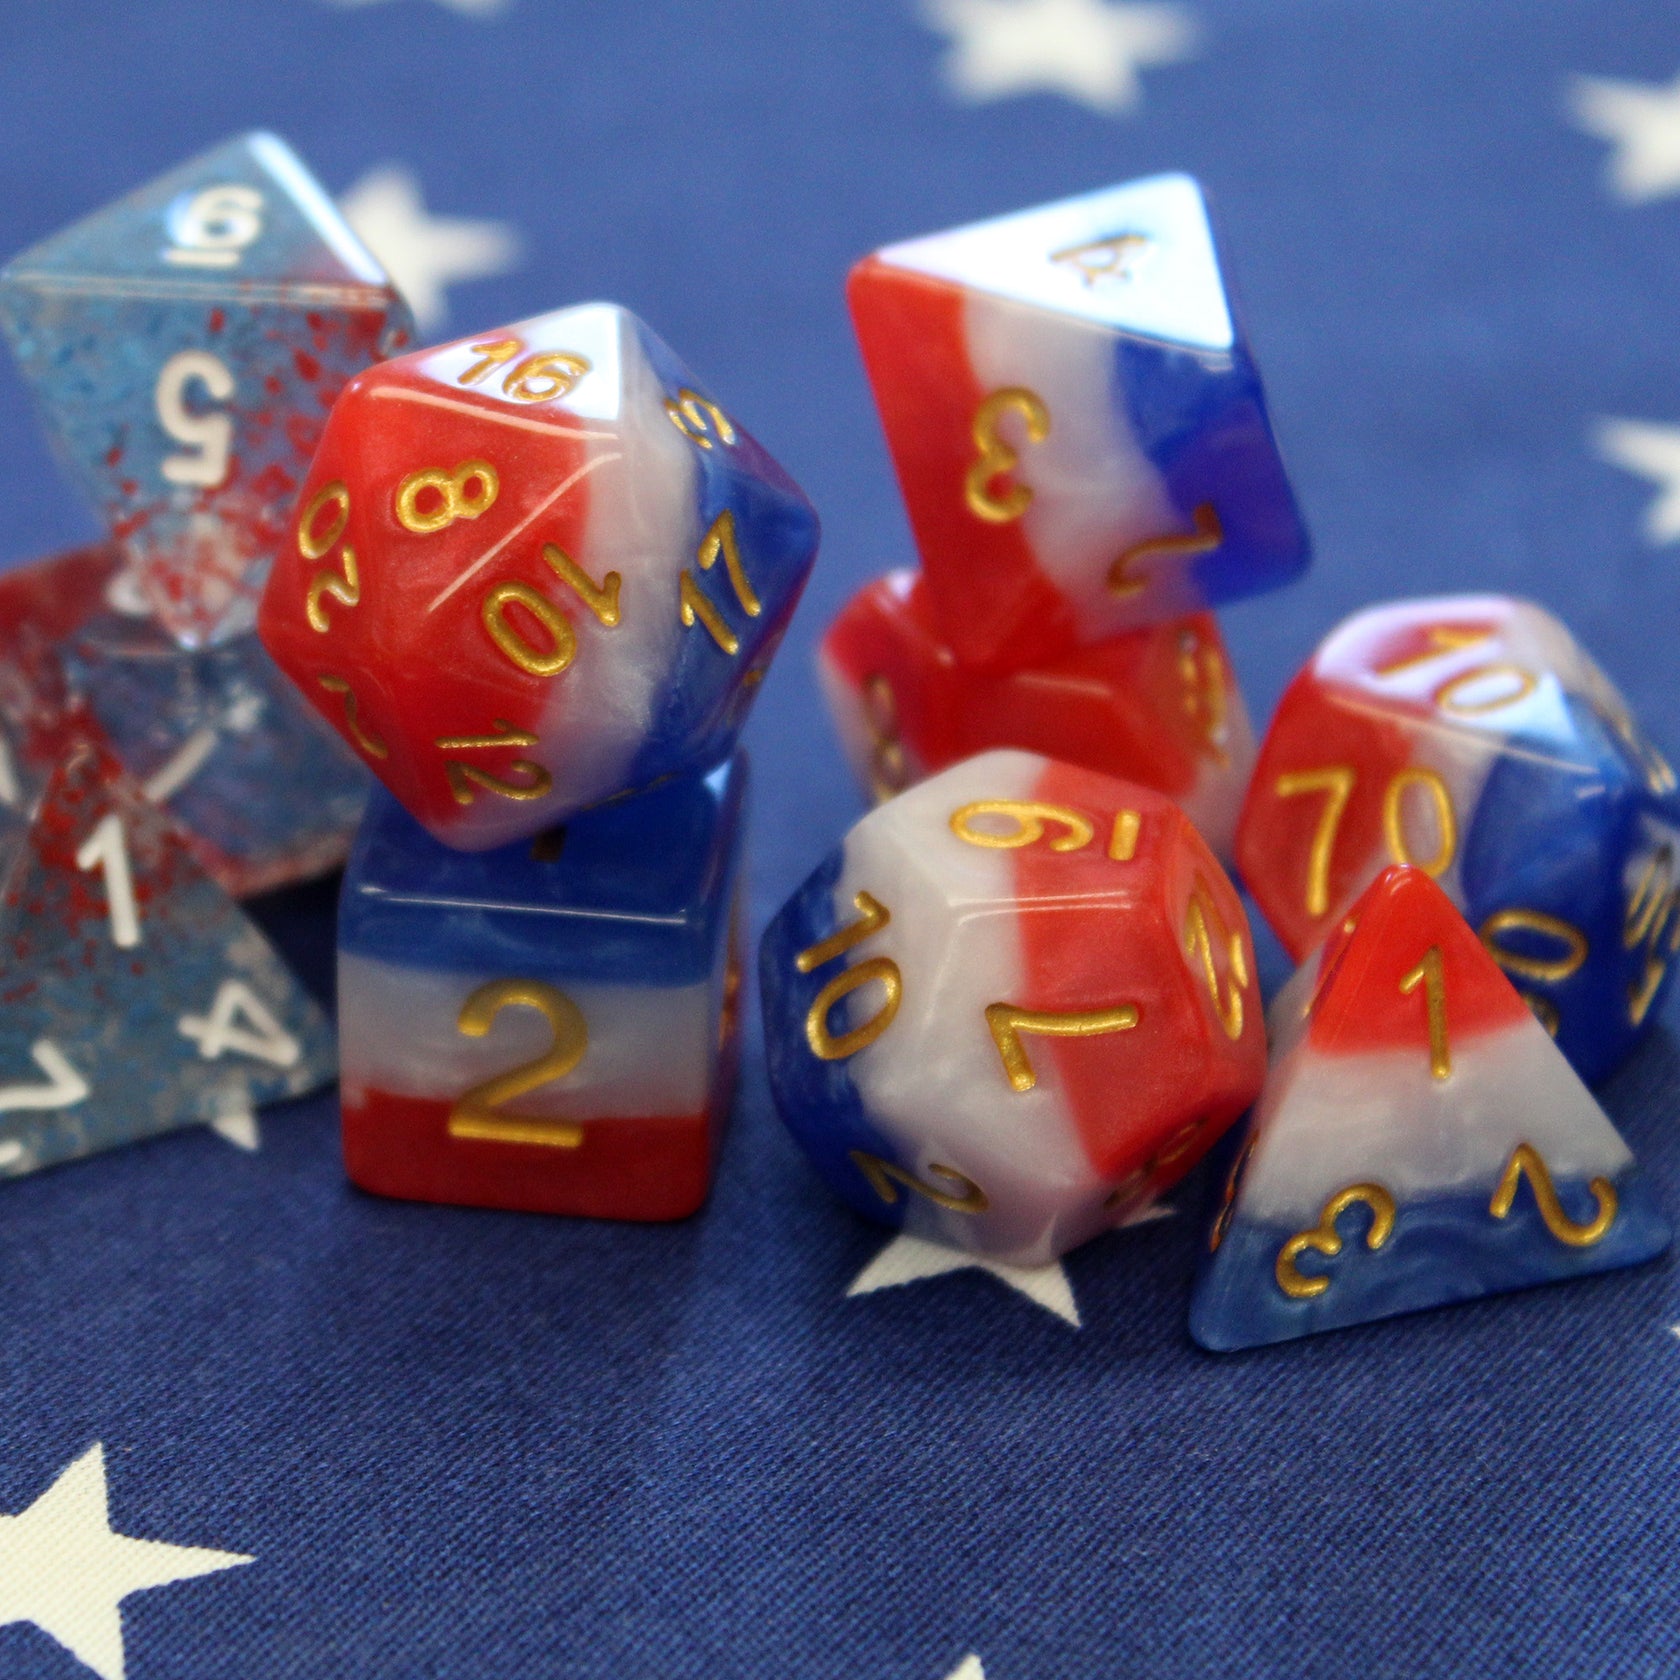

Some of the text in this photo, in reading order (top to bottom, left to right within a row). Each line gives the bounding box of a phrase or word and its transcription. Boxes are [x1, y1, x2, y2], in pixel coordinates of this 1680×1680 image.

[165, 184, 262, 266] 6
[155, 349, 234, 488] 5
[457, 338, 591, 402] 16
[395, 458, 499, 533] 8
[965, 386, 1050, 523] 3
[298, 478, 360, 632] 20
[483, 543, 621, 678] 10
[680, 509, 761, 656] 17
[1368, 622, 1540, 716] 10
[434, 718, 553, 806] 12
[76, 814, 140, 947] 1
[1275, 768, 1457, 916] 70
[177, 978, 299, 1066] 4
[794, 890, 904, 1061] 10
[1400, 944, 1451, 1080] 1
[447, 977, 589, 1149] 2
[984, 1001, 1139, 1092] 7
[1275, 1182, 1396, 1298] 3
[1489, 1142, 1617, 1247] 2
